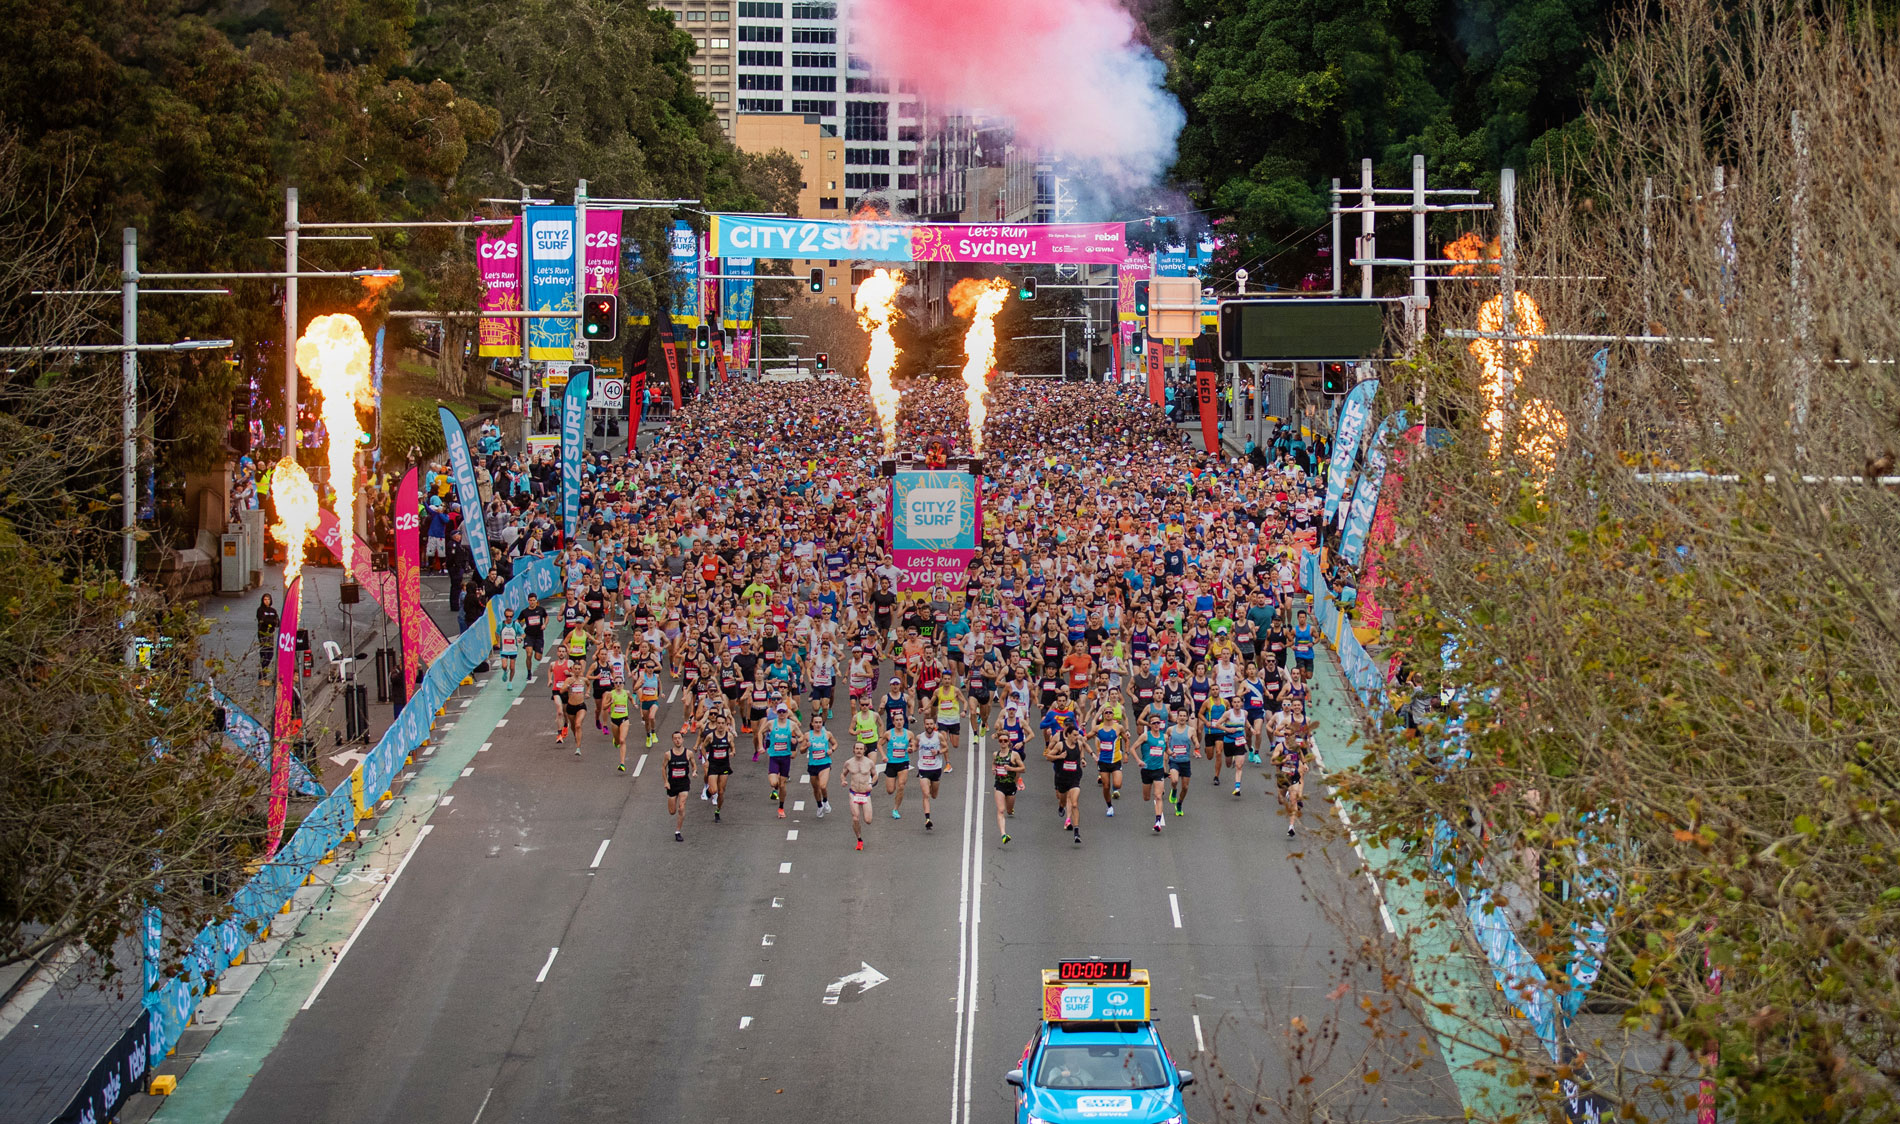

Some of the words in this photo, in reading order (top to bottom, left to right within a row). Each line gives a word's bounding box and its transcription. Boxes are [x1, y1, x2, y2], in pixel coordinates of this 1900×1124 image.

[536, 229, 569, 241] CITY2
[968, 225, 999, 239] Let's
[1001, 226, 1028, 239] Run
[1094, 232, 1119, 241] rebel
[538, 240, 567, 250] SURF
[673, 236, 694, 244] ITY2
[480, 240, 518, 260] C2S
[959, 239, 1037, 259] Sydney!
[537, 266, 553, 274] Let's
[554, 267, 569, 275] Run
[482, 279, 519, 290] ydney!
[533, 274, 574, 287] Sydney!
[606, 385, 621, 396] 40
[911, 499, 956, 514] CITY2
[914, 514, 953, 526] SURF
[907, 556, 934, 567] Let's
[936, 556, 961, 567] Run
[1064, 995, 1090, 1004] CITY2
[1066, 1003, 1089, 1011] SURF
[1102, 1008, 1133, 1016] GWM
